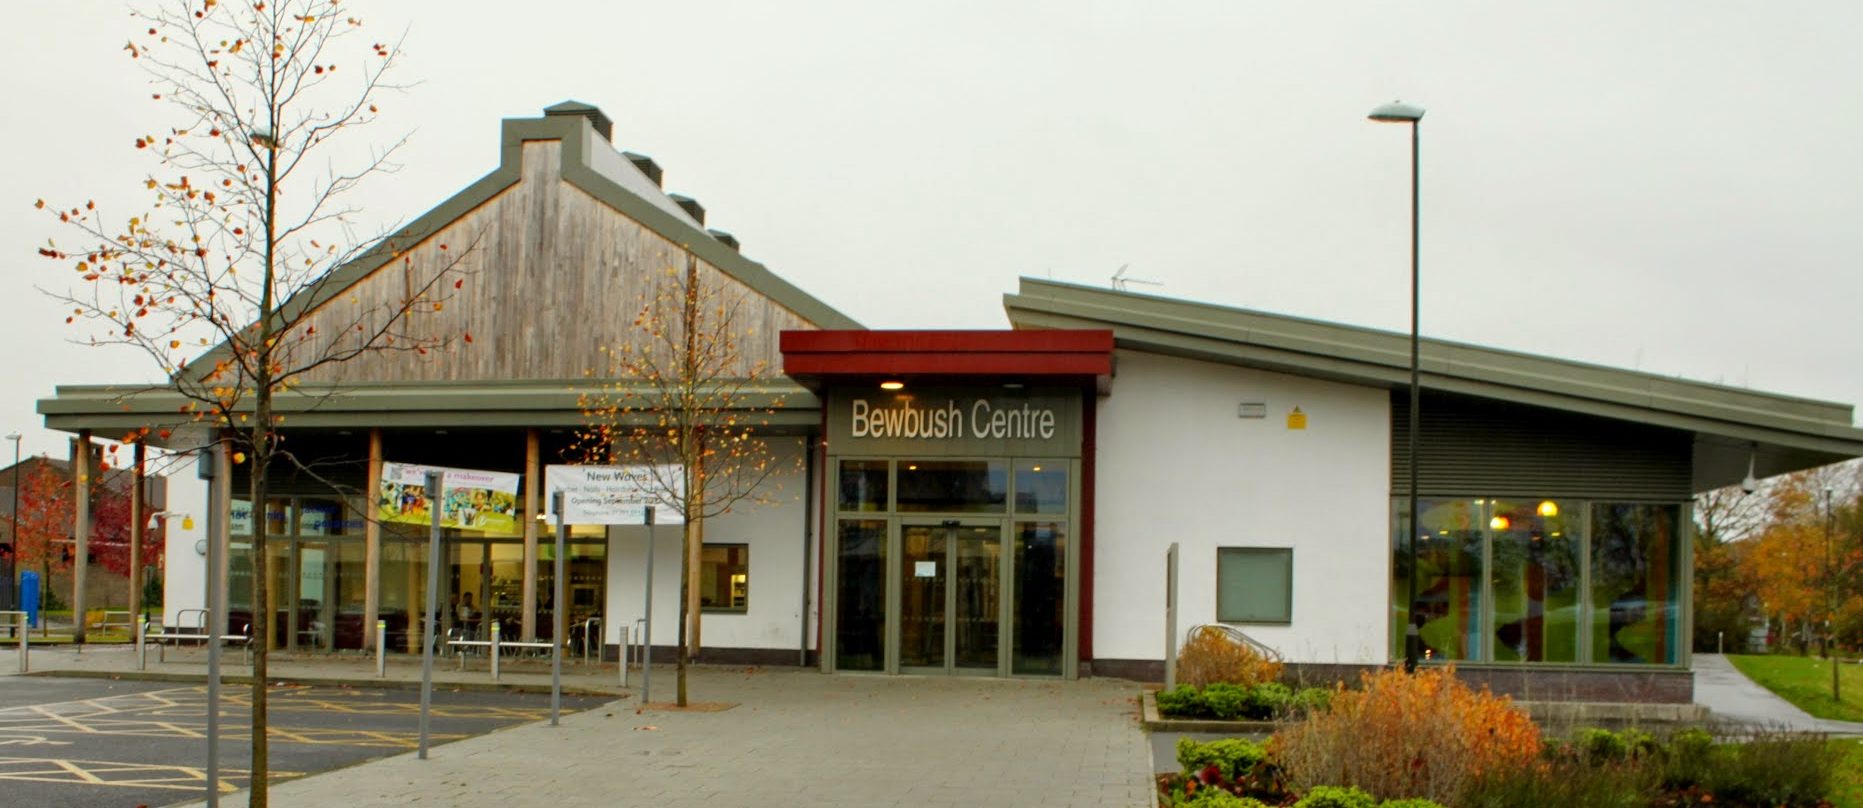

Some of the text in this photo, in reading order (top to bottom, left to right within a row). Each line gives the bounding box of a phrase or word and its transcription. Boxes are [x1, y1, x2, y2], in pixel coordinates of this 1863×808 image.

[852, 399, 1055, 439] Bewbush Centre
[587, 472, 648, 481] New Waves
[571, 496, 602, 507] Opening
